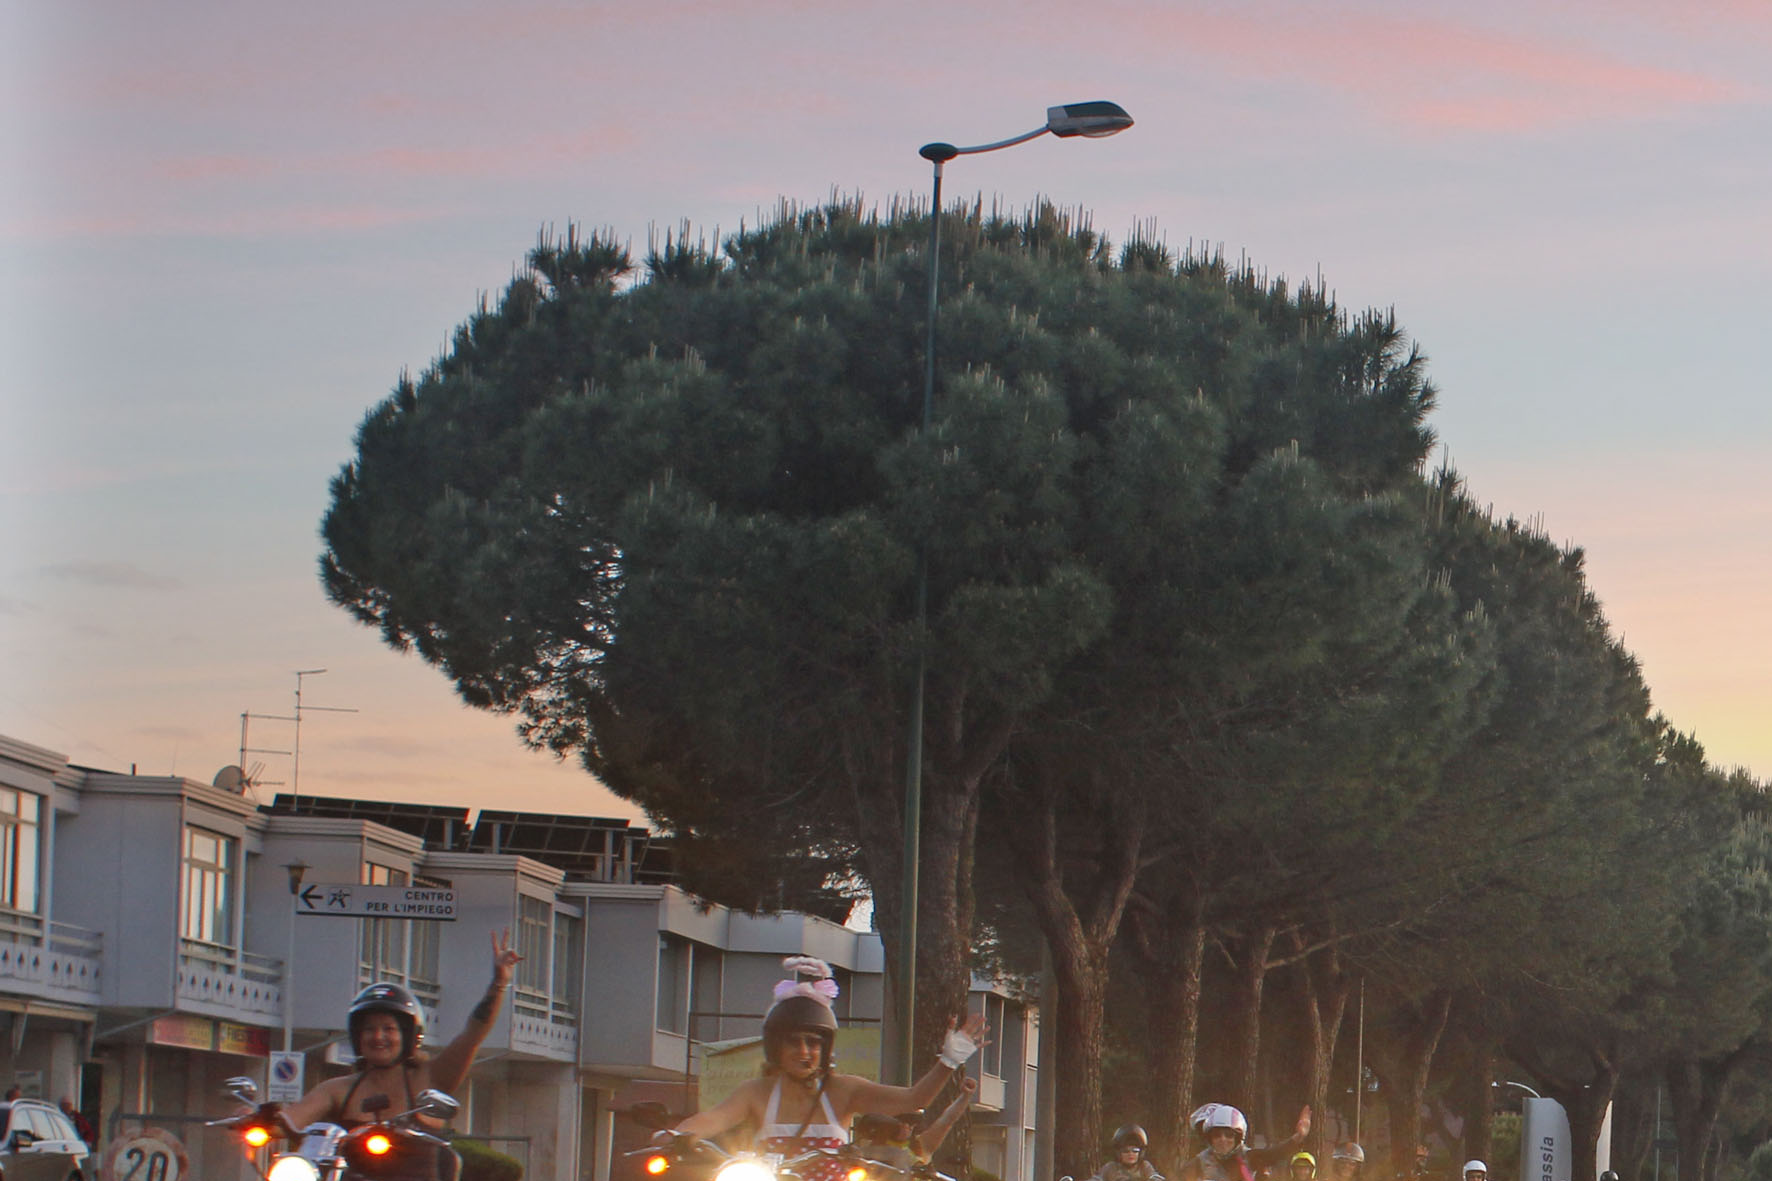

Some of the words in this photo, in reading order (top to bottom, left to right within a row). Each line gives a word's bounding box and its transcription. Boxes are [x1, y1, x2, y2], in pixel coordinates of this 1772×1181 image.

[405, 891, 454, 902] CENTRO
[366, 902, 389, 912] PER
[394, 903, 454, 915] L'IMPIEGO
